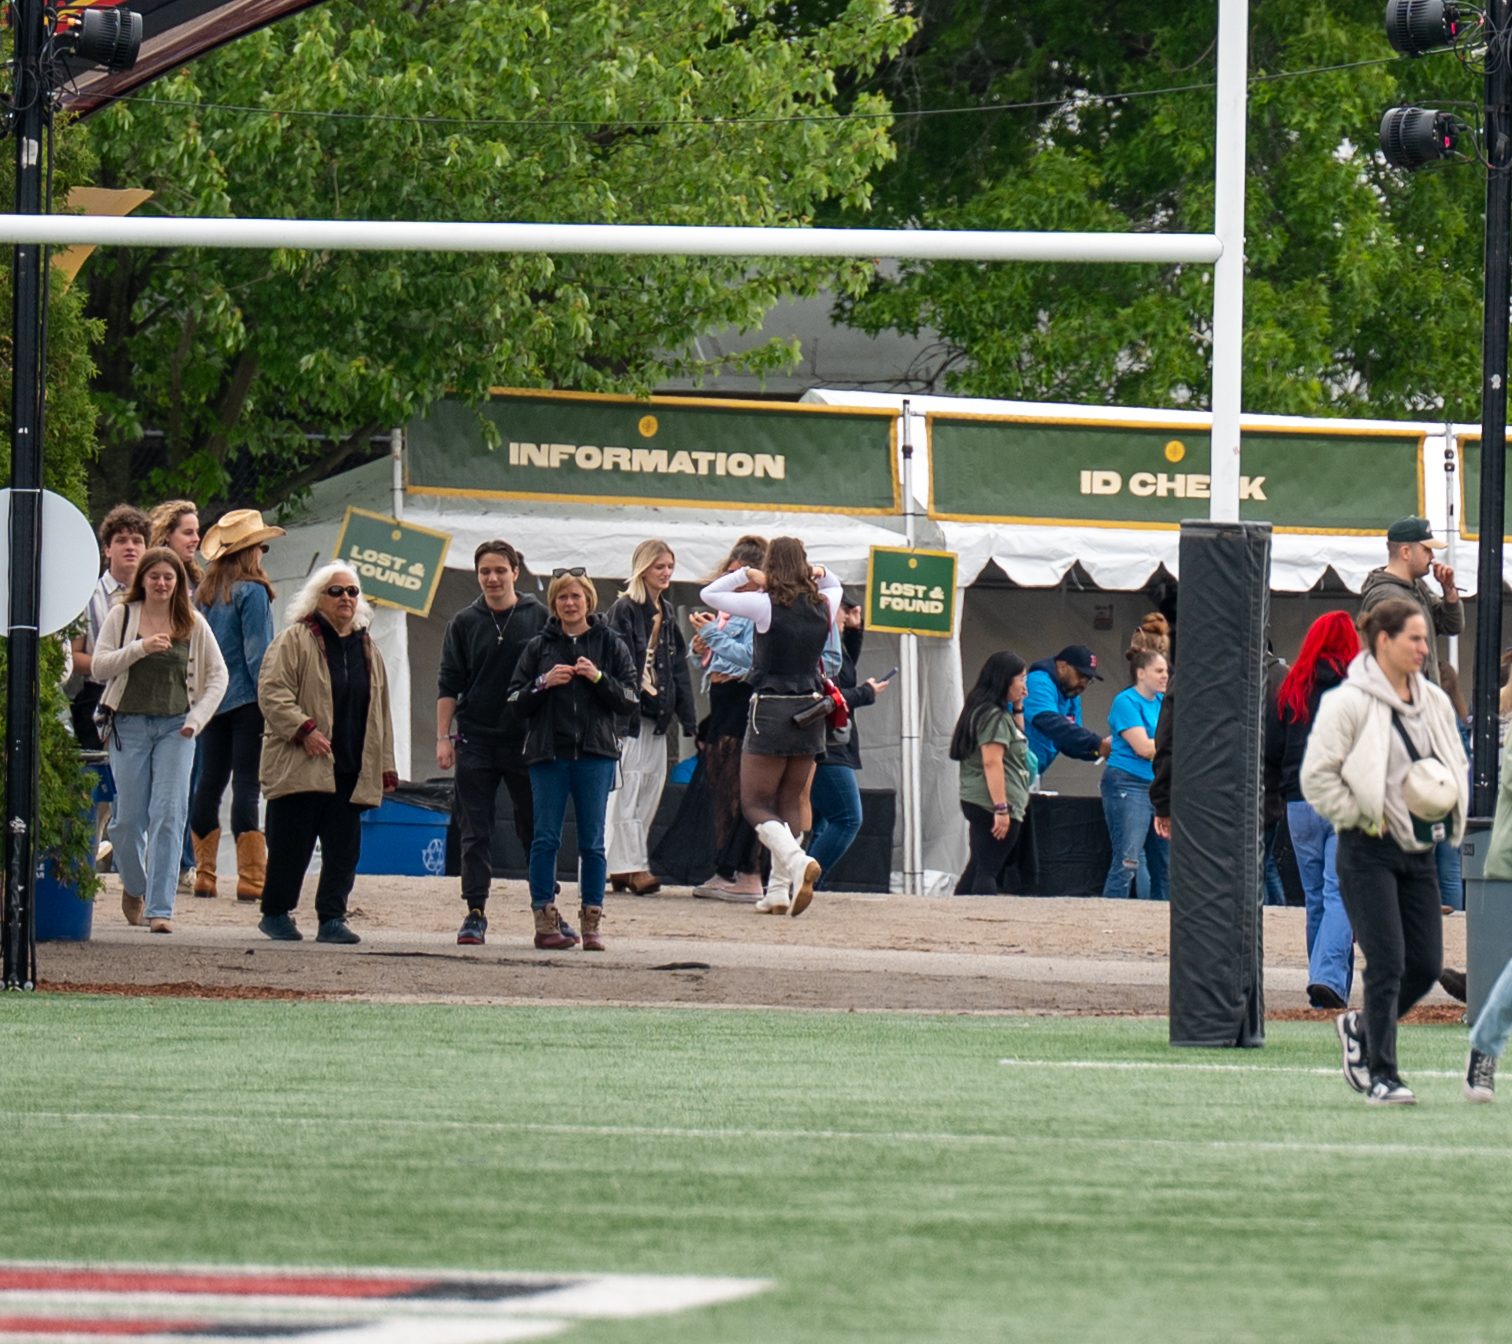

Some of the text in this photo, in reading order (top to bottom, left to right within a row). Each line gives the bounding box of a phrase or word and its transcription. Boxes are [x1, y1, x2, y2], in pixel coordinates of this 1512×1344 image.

[508, 442, 786, 480] INFORMATION
[1080, 469, 1268, 501] ID CHEK
[349, 544, 426, 578] LOST &
[879, 580, 945, 600] LOST &
[879, 595, 945, 615] FOUND
